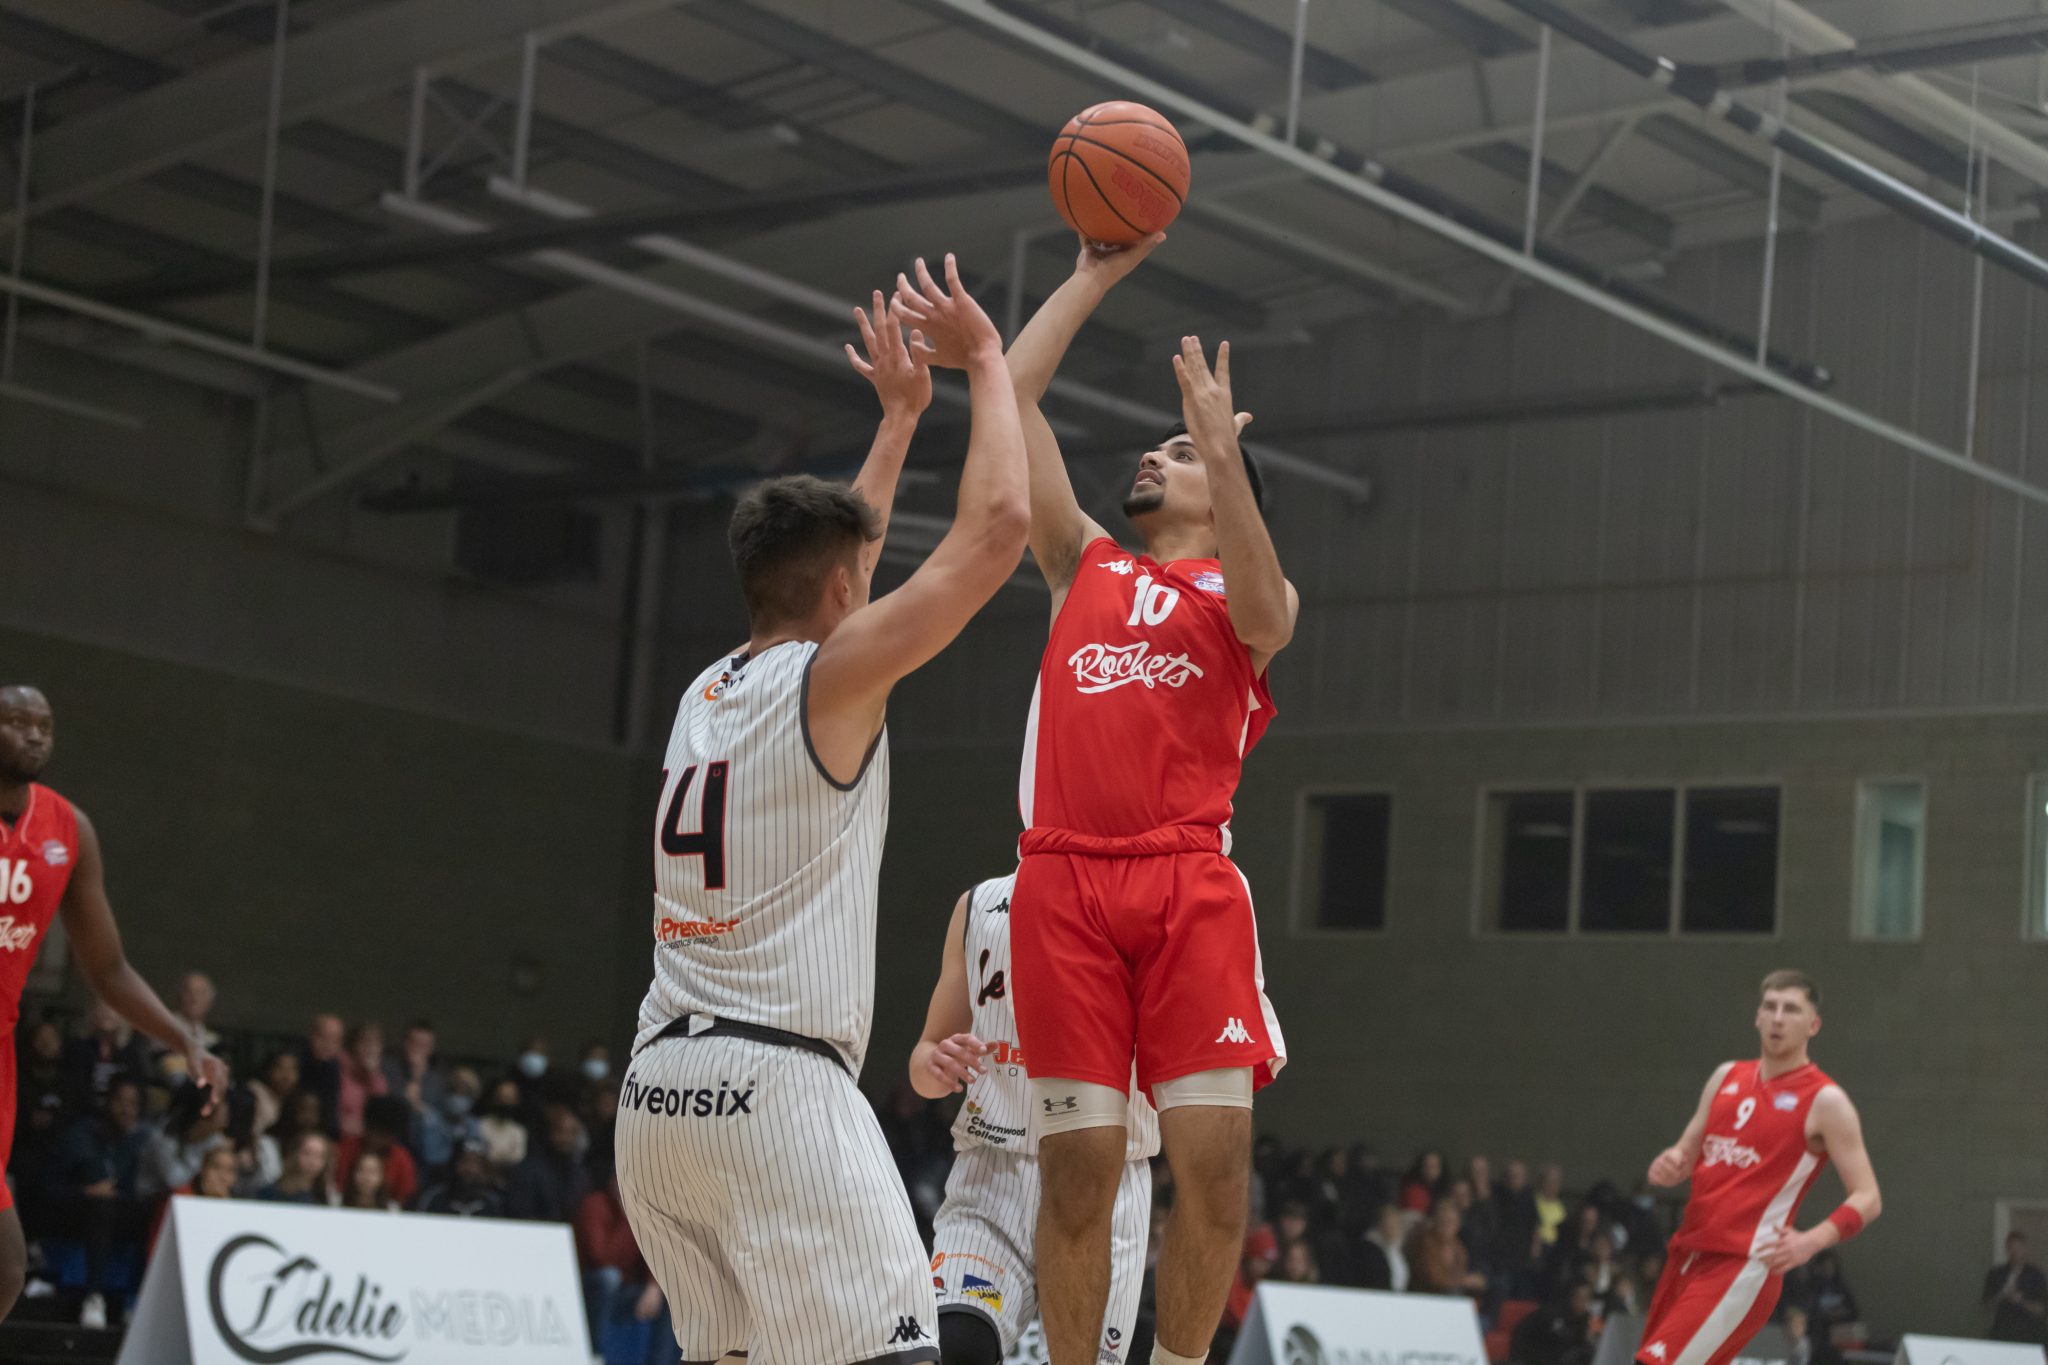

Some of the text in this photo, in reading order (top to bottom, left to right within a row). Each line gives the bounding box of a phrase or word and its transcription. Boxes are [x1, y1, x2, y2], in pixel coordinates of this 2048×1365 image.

[1127, 575, 1180, 626] 10
[1068, 641, 1204, 694] Rockets
[654, 760, 730, 891] 4
[0, 858, 33, 904] 16
[661, 916, 740, 942] Premier
[621, 1072, 755, 1118] fiveorsix
[1733, 1097, 1756, 1130] 9
[967, 1125, 1007, 1144] College
[971, 1116, 1026, 1136] Charnwood
[410, 1288, 573, 1347] MEDIA
